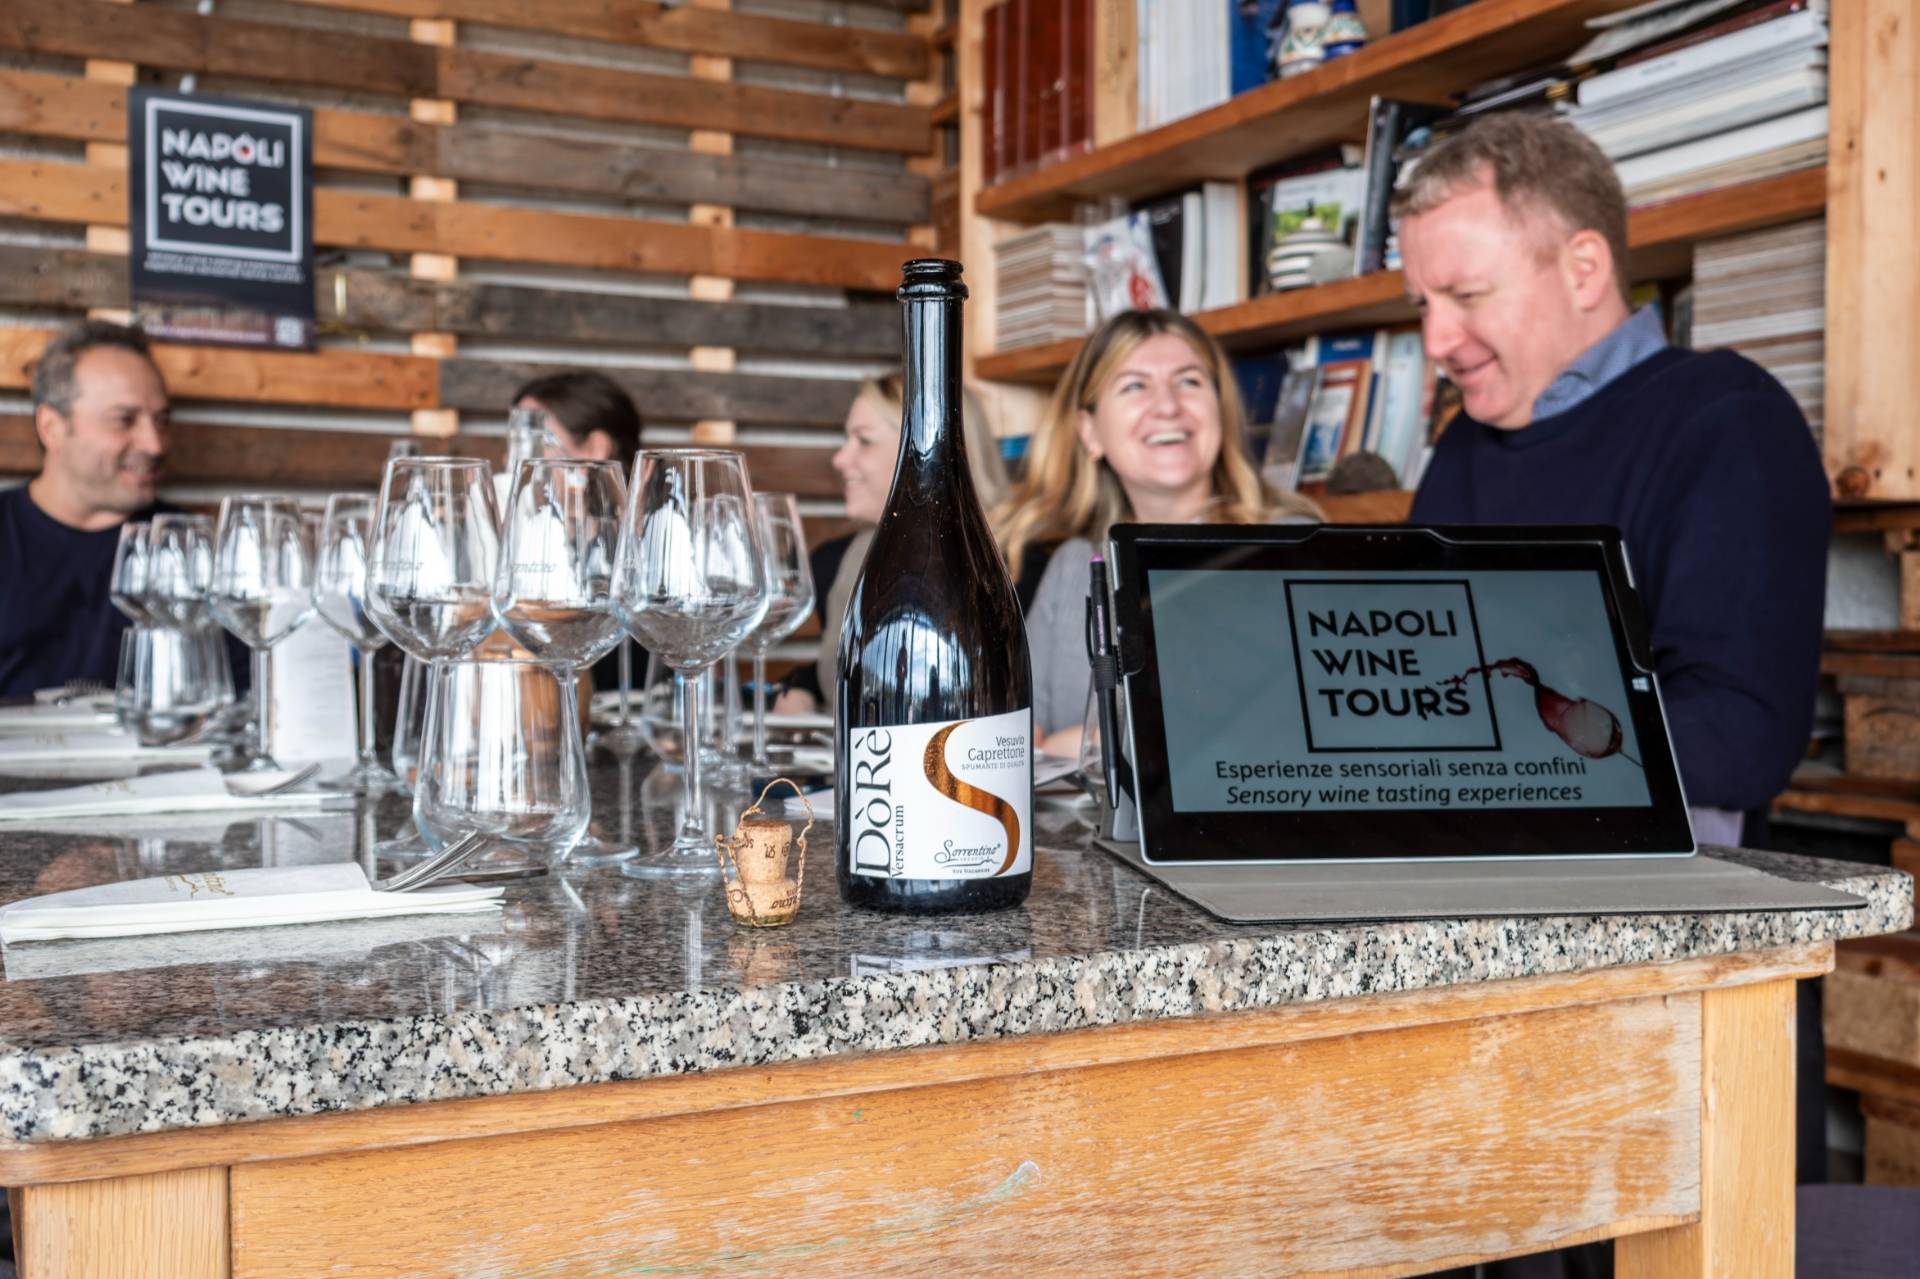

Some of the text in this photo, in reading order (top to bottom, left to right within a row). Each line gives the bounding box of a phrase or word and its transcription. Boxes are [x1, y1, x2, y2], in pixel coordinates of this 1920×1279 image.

[162, 127, 284, 168] NAPOLI
[161, 159, 251, 197] WINE
[161, 193, 284, 233] TOURS
[1308, 609, 1457, 638] NAPOLI
[1311, 648, 1422, 677] WINE
[1319, 687, 1471, 720] TOURS
[968, 747, 1025, 763] Caprettone
[995, 735, 1025, 747] Vesuvio
[1215, 756, 1587, 783] Esperienze sensoriali senza confini
[1226, 782, 1583, 808] Sensory wine tasting experiences
[892, 804, 905, 878] Versacrum
[934, 839, 996, 864] Sorrentino
